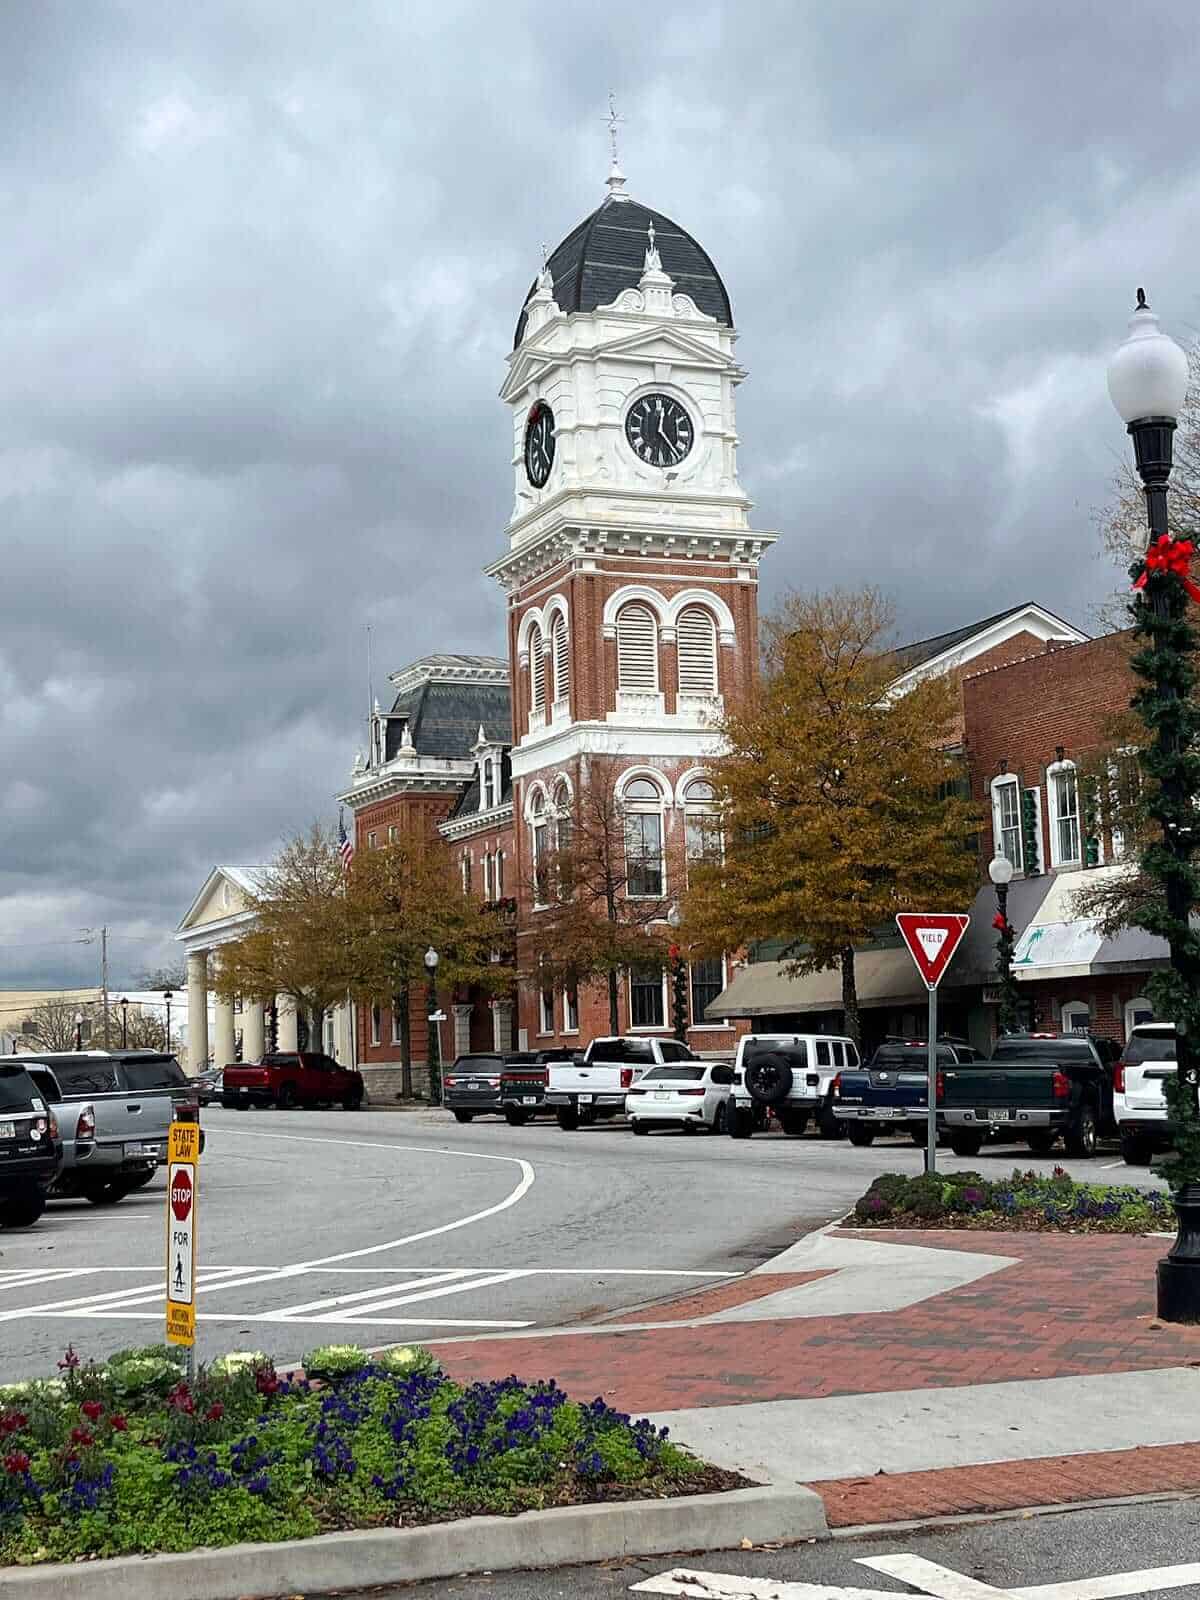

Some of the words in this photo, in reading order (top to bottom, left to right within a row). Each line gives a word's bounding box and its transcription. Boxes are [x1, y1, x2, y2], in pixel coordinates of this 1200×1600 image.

[921, 933, 943, 944] YIELD
[173, 1128, 195, 1143] STATE
[175, 1144, 192, 1157] LAW
[172, 1188, 191, 1203] STOP
[173, 1231, 189, 1246] FOR
